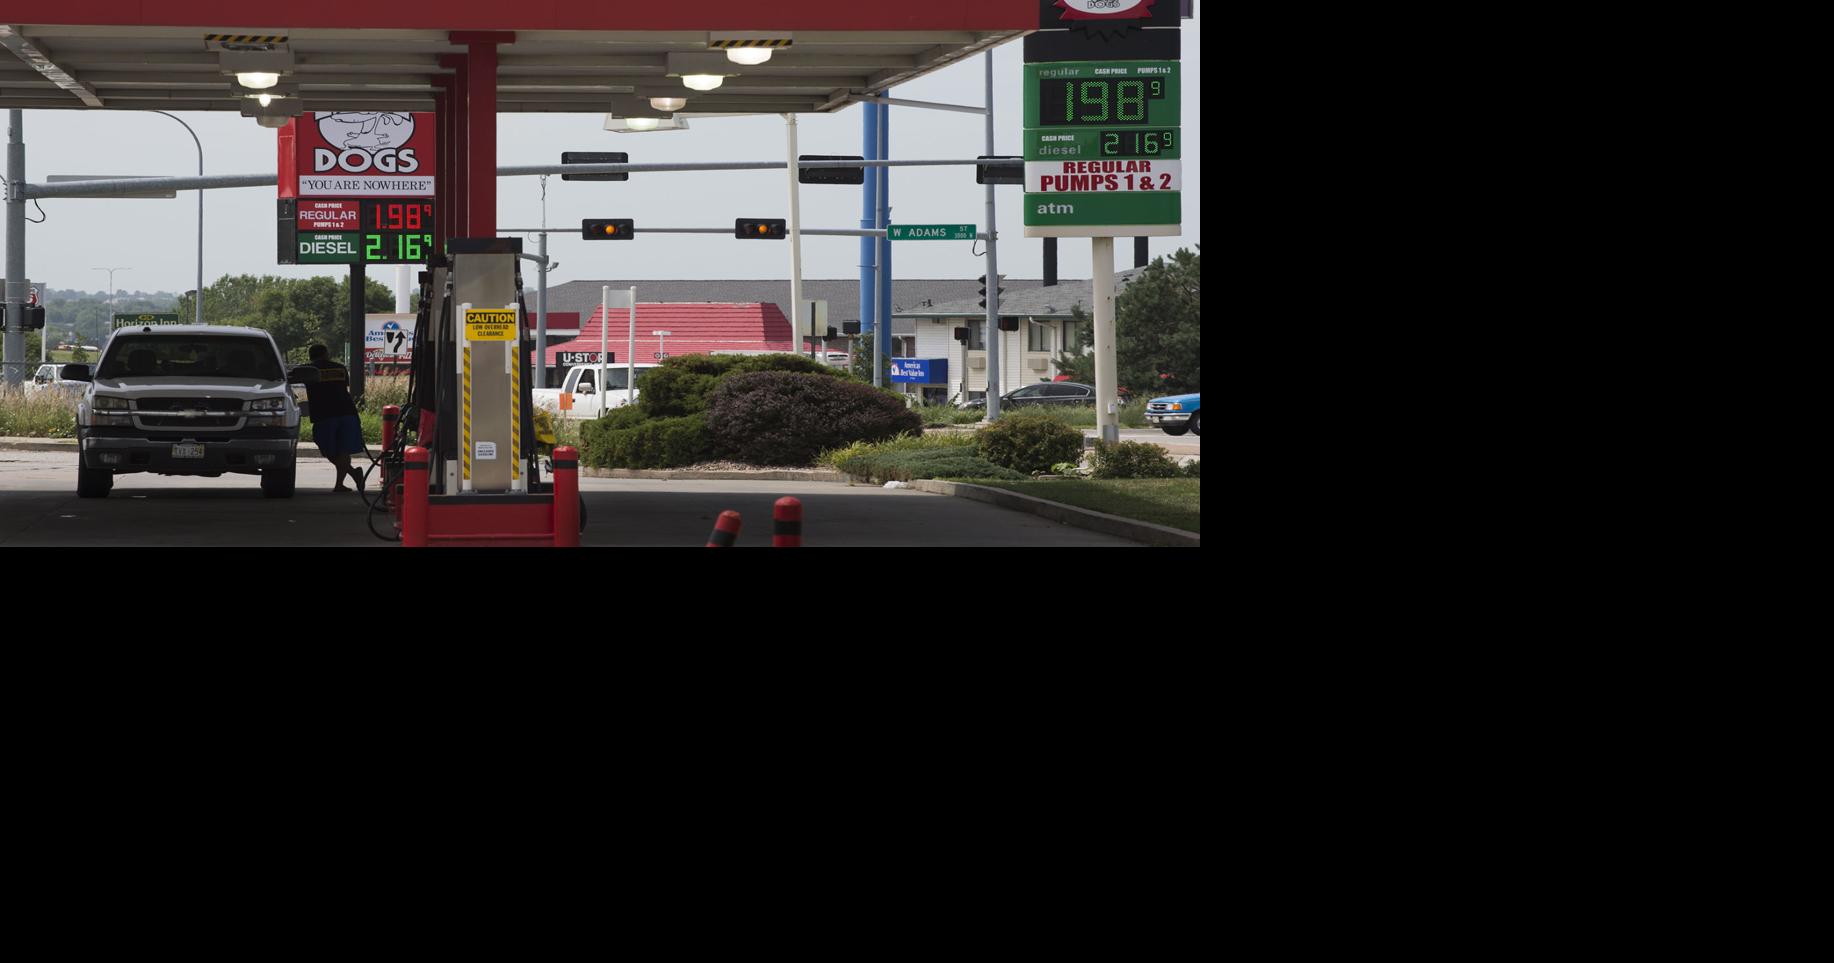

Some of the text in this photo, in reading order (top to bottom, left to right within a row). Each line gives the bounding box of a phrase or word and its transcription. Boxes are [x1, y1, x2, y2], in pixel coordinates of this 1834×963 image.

[1039, 68, 1080, 77] regular
[1039, 145, 1081, 155] diesel
[314, 147, 419, 173] DOGS
[1063, 160, 1152, 174] REGULAR
[335, 180, 360, 190] ARE
[1040, 173, 1172, 192] PUMPS 1 & 2
[1037, 202, 1074, 215] atm
[300, 211, 357, 220] REGULAR
[893, 228, 901, 237] W
[908, 228, 946, 237] ADAMS
[300, 242, 357, 254] DIESEL
[116, 318, 177, 327] Horizon Inn
[467, 313, 515, 323] CAUTION
